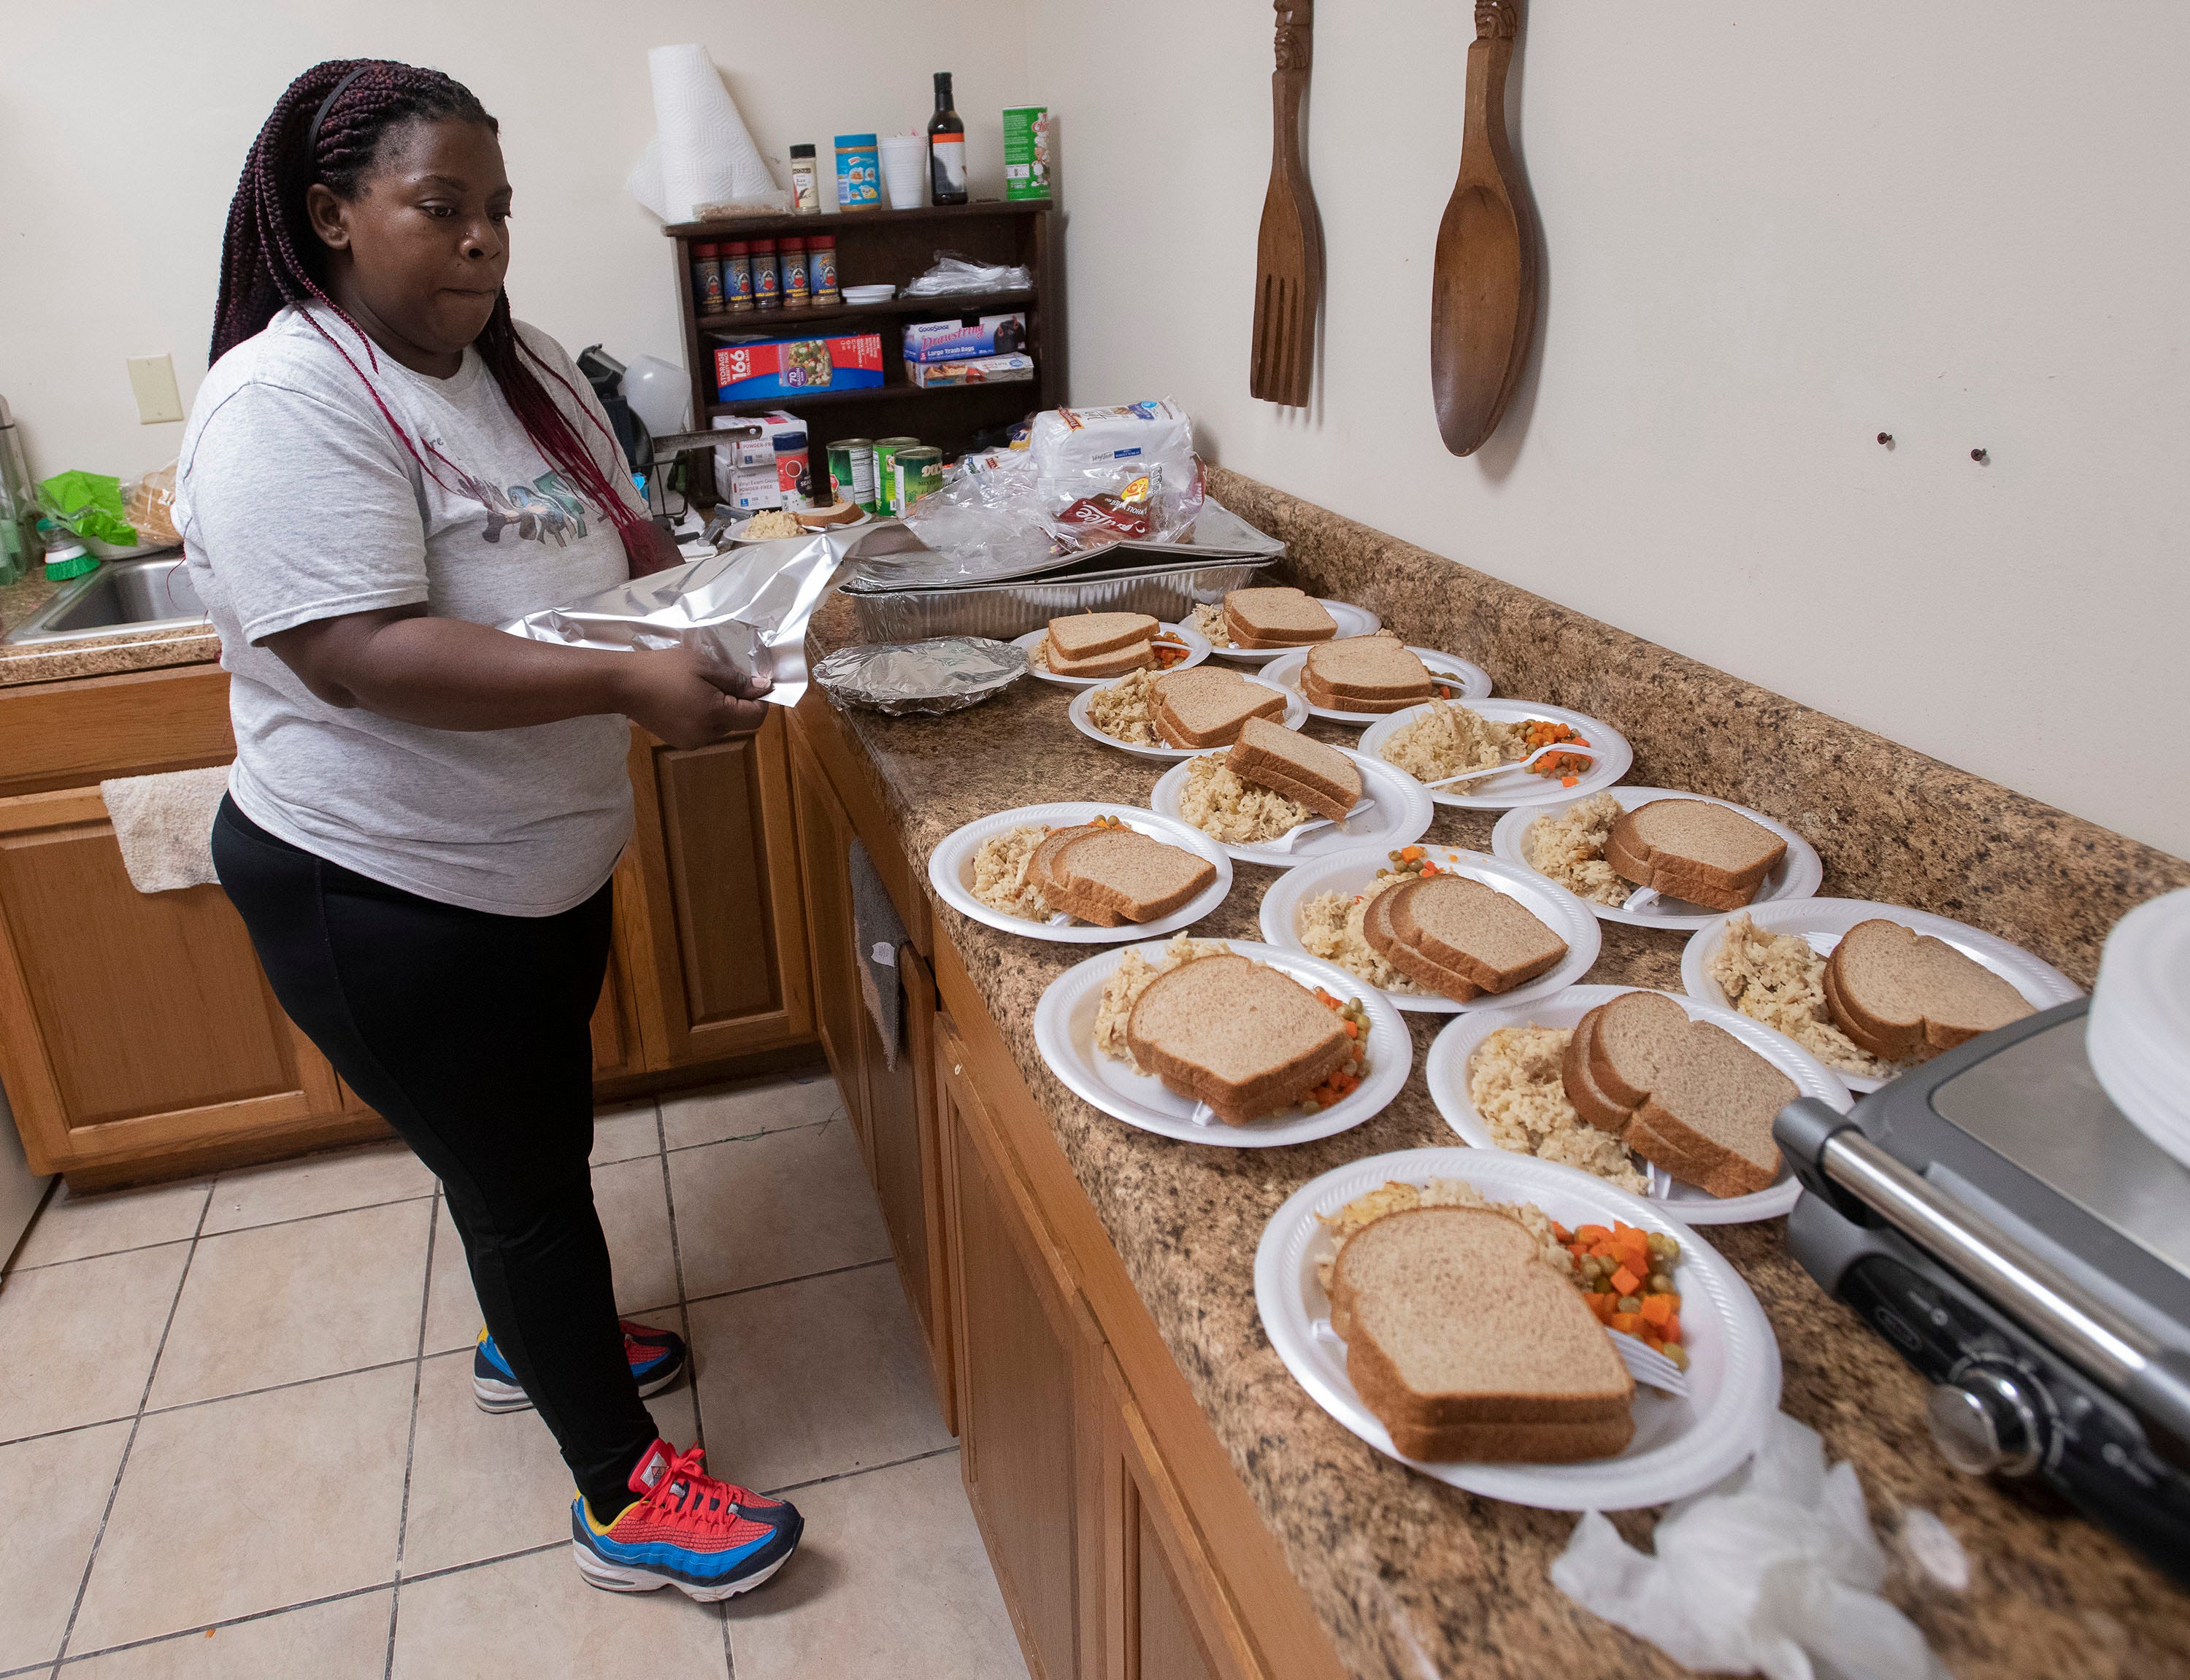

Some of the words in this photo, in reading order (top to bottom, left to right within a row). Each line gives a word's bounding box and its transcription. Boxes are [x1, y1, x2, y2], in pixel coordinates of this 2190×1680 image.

[921, 323, 985, 351] Drawstring
[928, 349, 944, 357] Large
[945, 347, 960, 355] Trash
[718, 352, 727, 385] STORAGE
[730, 350, 747, 380] 166
[788, 371, 797, 383] 70
[1127, 505, 1144, 515] WHOLE
